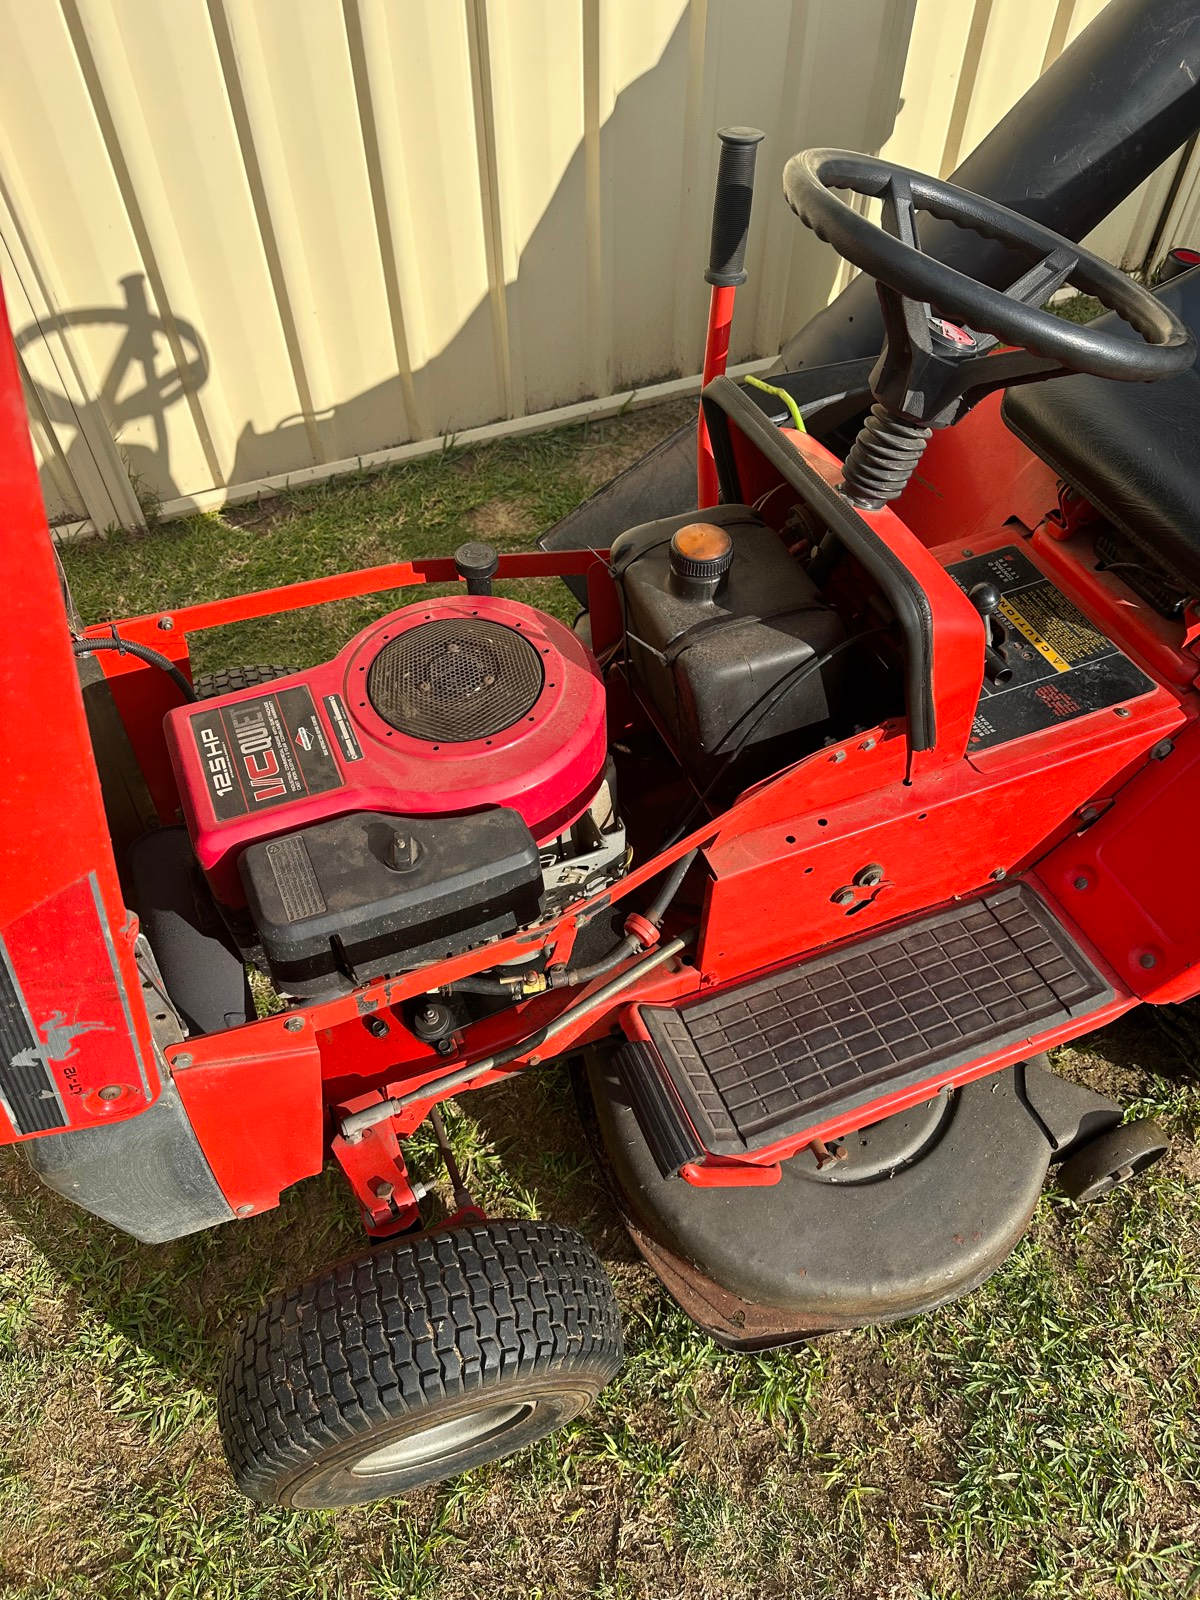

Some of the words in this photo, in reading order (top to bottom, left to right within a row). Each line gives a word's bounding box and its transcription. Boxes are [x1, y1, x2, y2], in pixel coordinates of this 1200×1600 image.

[994, 561, 1014, 580] CONTROL
[999, 559, 1019, 579] LEVER
[994, 609, 1015, 629] REVER
[999, 599, 1050, 652] CAUTION
[230, 704, 273, 754] QUIET
[973, 717, 991, 735] CLUTC
[978, 714, 997, 733] PEDAL
[201, 728, 221, 757] HP
